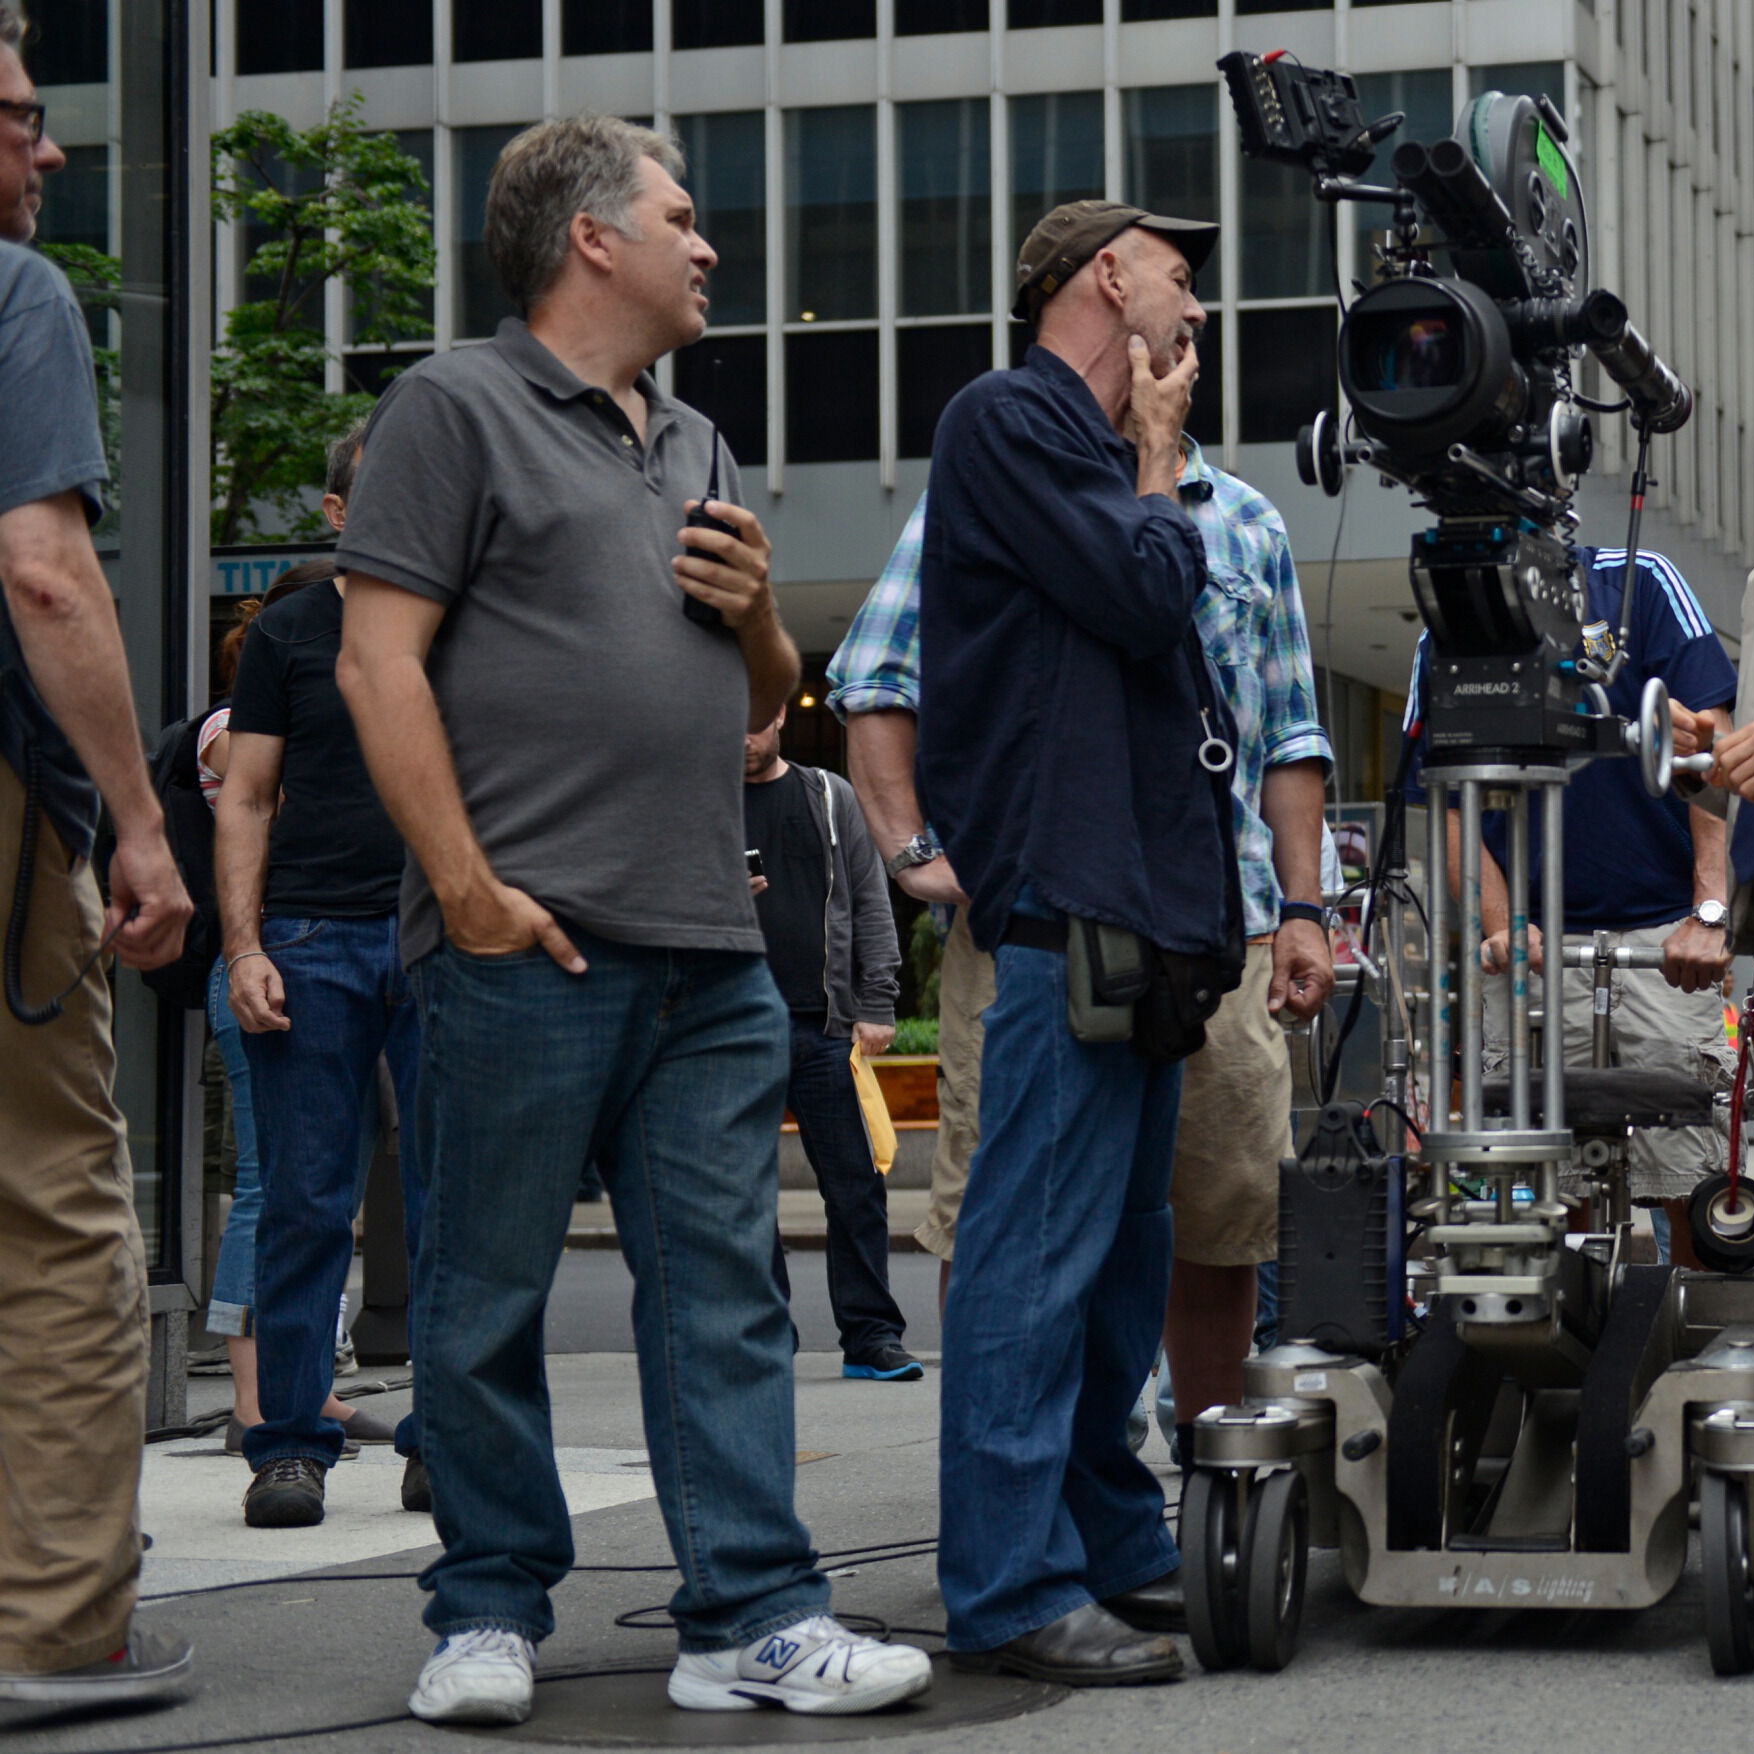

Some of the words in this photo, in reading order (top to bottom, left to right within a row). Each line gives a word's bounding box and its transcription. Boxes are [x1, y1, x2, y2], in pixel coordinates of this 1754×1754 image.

[217, 560, 300, 593] TIT
[1453, 682, 1510, 696] ARRIHEAD
[1511, 681, 1521, 695] 2
